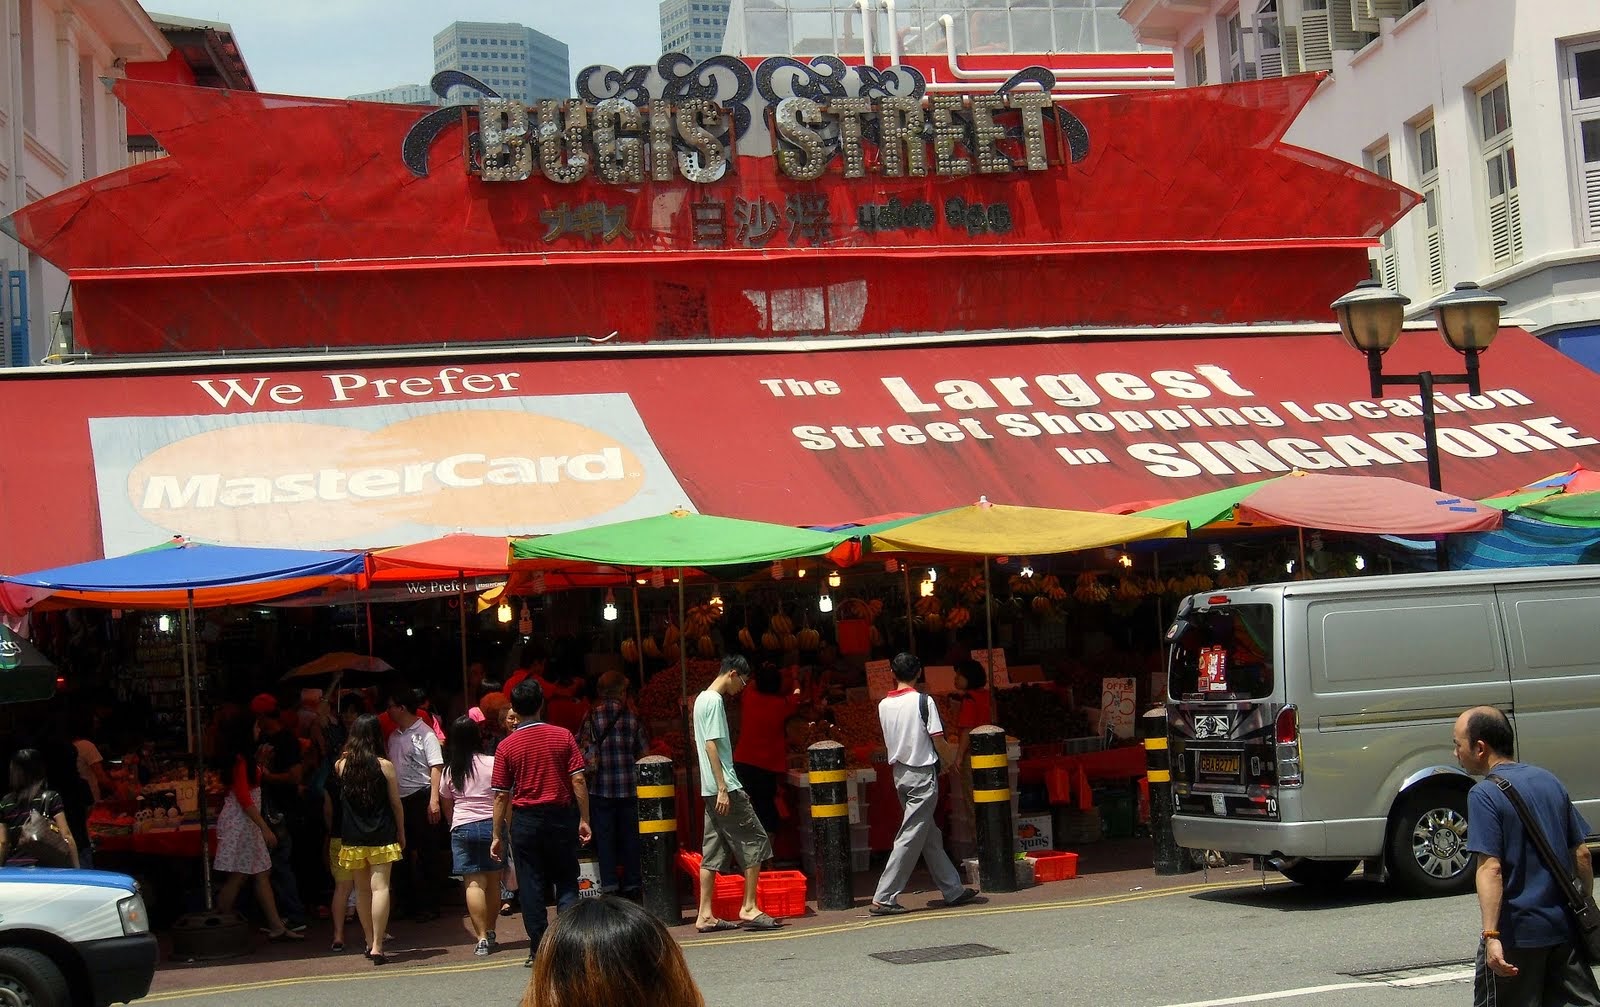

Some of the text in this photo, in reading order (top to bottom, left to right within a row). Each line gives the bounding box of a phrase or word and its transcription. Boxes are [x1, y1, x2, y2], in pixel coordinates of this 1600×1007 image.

[479, 91, 1054, 183] BUGIS STREET
[191, 367, 520, 408] We Prefer
[759, 363, 1255, 413] The Largest
[791, 387, 1535, 450] Street Shopping Location
[1055, 416, 1600, 478] In SINGAPORE
[142, 447, 625, 510] MasterCard
[406, 582, 427, 594] We
[430, 580, 468, 593] Prefer
[1265, 799, 1277, 812] 70
